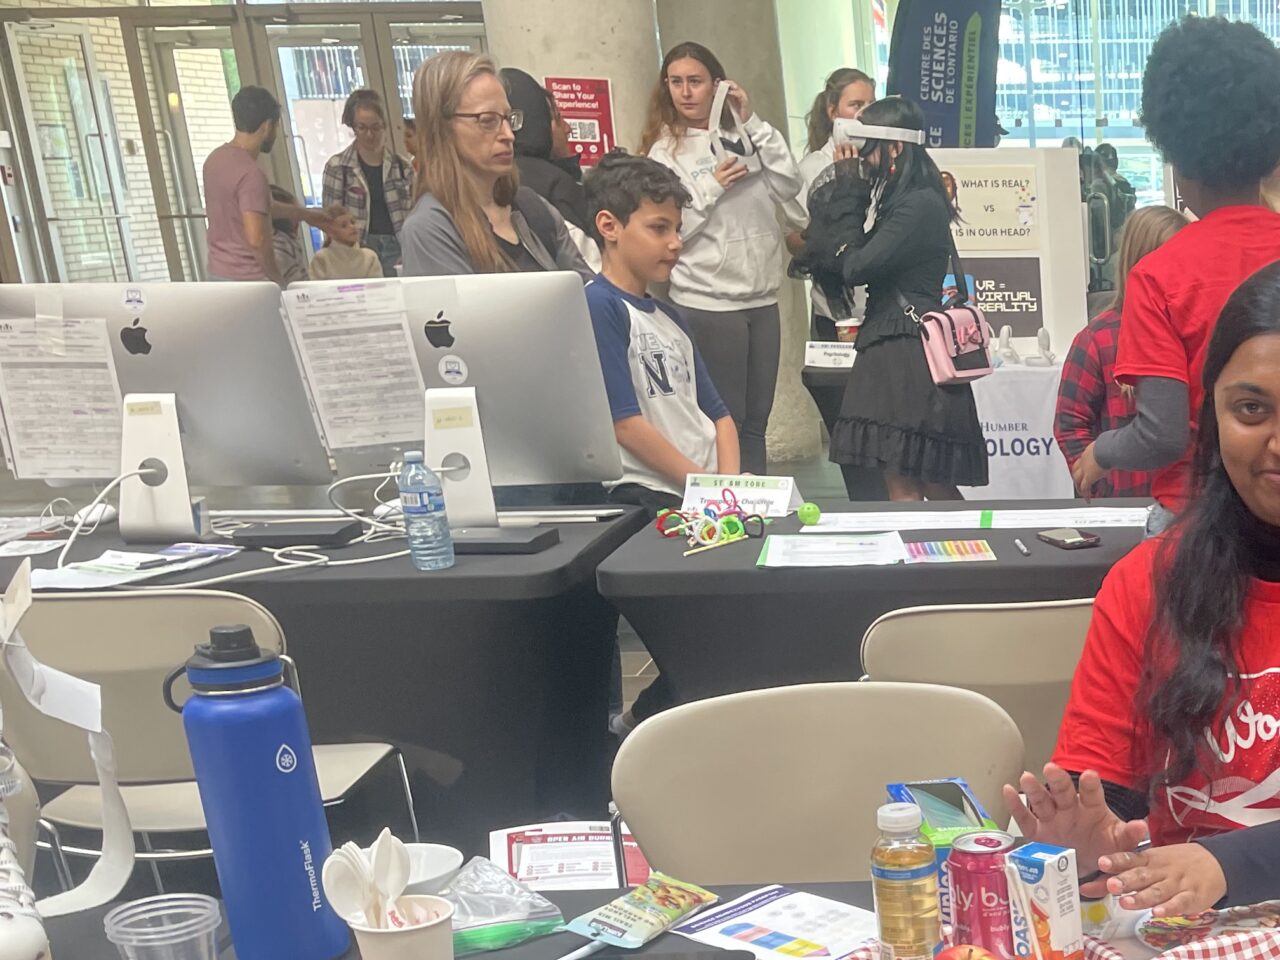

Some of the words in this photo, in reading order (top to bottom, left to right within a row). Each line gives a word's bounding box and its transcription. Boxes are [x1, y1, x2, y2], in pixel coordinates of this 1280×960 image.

[923, 26, 931, 50] DES
[931, 11, 947, 102] SCIENCES
[946, 20, 959, 85] L'ONTARIO
[920, 53, 931, 100] CENTRE
[552, 82, 570, 90] Scan
[553, 91, 575, 99] Share
[945, 90, 954, 103] DE
[961, 180, 988, 188] WHAT
[991, 180, 999, 188] IS
[1002, 180, 1029, 188] REAL?
[1001, 228, 1030, 236] HEAD?
[976, 280, 995, 290] VR
[977, 292, 1036, 301] VIRTUAL
[977, 302, 1037, 311] REALITY
[639, 351, 675, 398] N
[981, 422, 1028, 432] HUMBER
[305, 840, 322, 912] ThermoFlask
